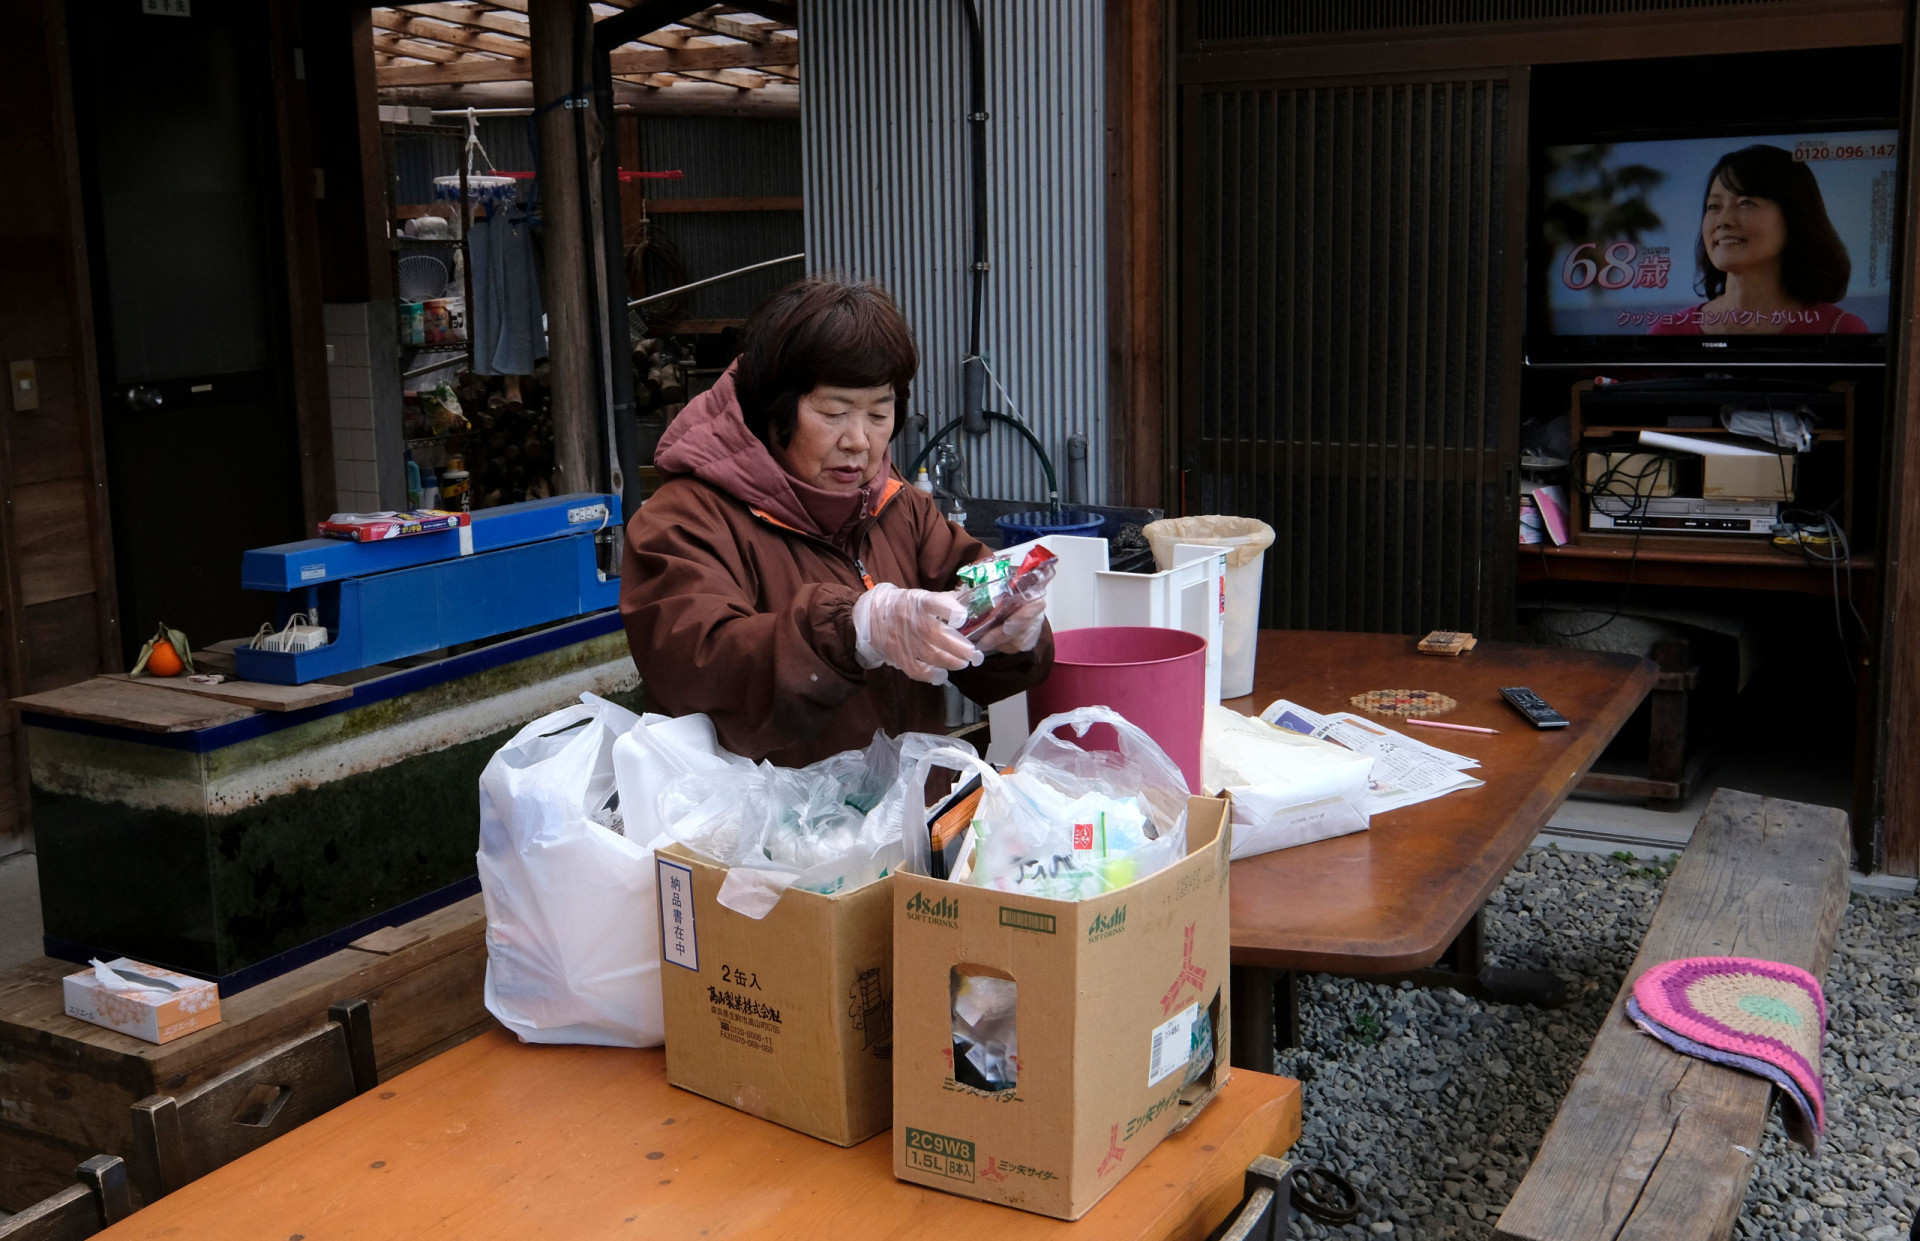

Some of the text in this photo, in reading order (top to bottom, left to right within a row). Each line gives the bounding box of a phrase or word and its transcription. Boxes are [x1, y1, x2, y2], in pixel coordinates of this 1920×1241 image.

[1701, 341, 1728, 349] TOSHIBA
[670, 874, 686, 957] 納品書在中
[906, 889, 959, 920] Asahi
[906, 911, 960, 930] SOFT DRINKS
[1088, 903, 1127, 936] Asahi
[1088, 932, 1104, 944] SOFT
[721, 964, 762, 991] 2缶入
[69, 1006, 96, 1021] エリエール
[910, 1131, 970, 1159] 2C9W8
[911, 1151, 971, 1177] 1.5L 8本入
[997, 1159, 1059, 1181] 三ツ矢サイダー
